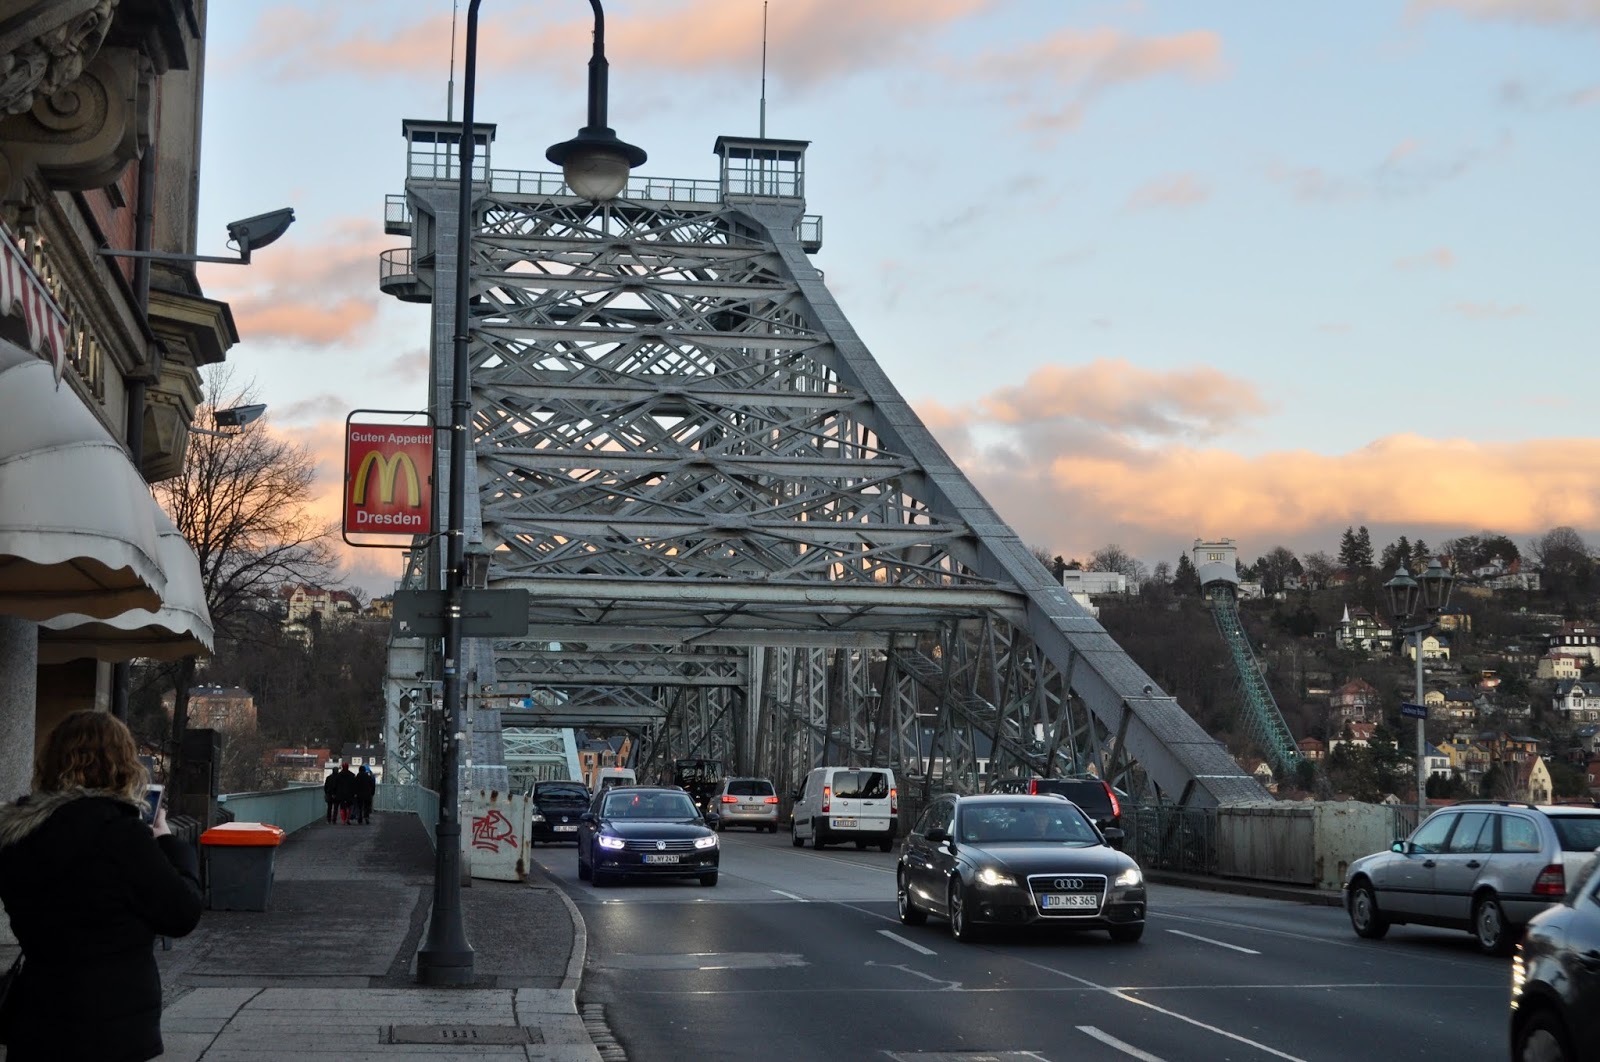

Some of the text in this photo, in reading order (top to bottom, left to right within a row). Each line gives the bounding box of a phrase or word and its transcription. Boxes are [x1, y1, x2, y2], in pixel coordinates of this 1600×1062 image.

[351, 431, 432, 445] Guten Appetit!
[356, 510, 421, 526] Dresden
[1048, 896, 1096, 906] DD MS 365
